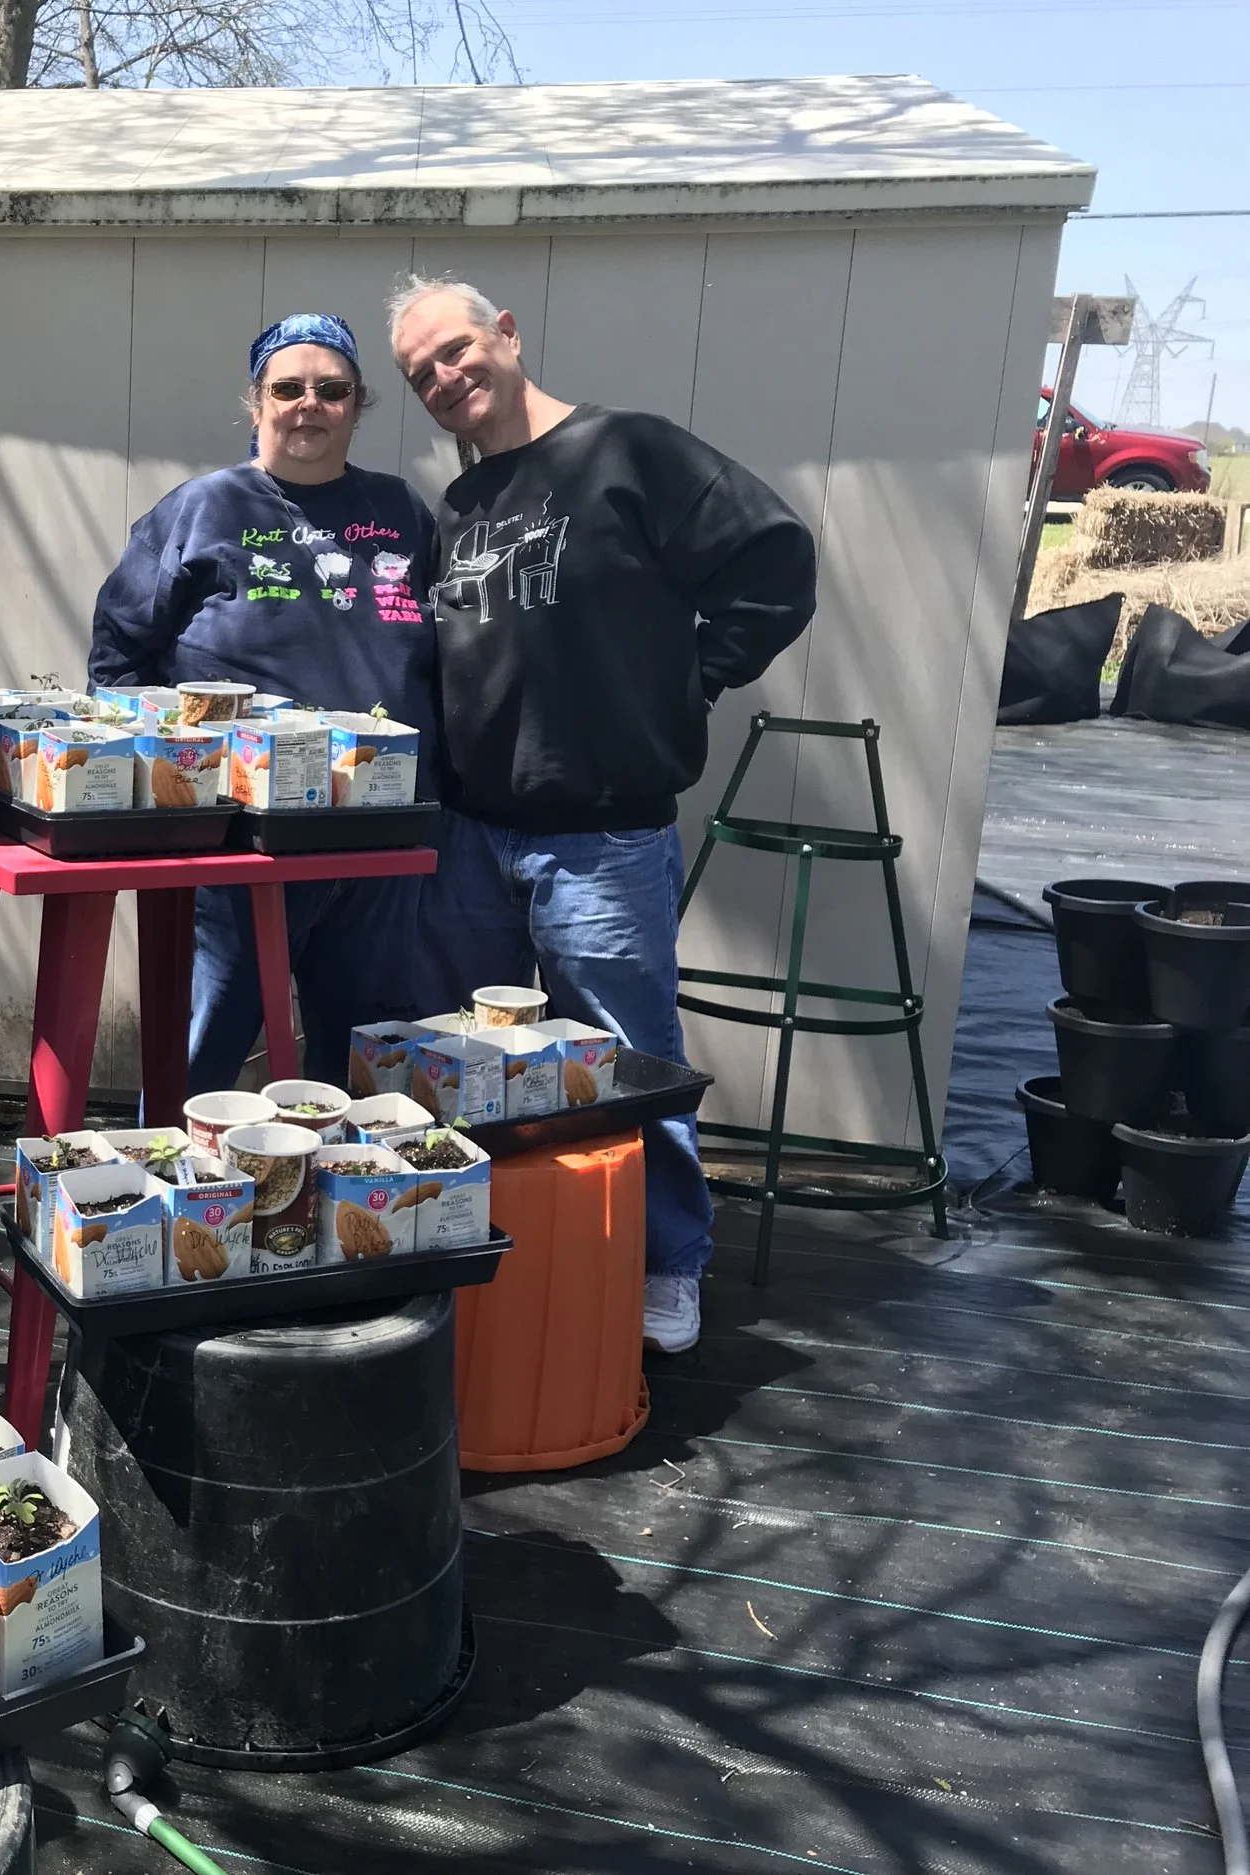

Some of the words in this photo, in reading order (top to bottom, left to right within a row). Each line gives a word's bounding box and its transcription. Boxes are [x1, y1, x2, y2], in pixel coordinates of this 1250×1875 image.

[242, 528, 287, 546] Knit
[345, 521, 400, 541] Others
[247, 585, 301, 601] SLEEP
[375, 596, 419, 609] WITH
[379, 610, 423, 623] YARN
[198, 1191, 233, 1199] ORIGINAL
[372, 1192, 385, 1202] 30
[442, 1197, 472, 1207] REASONS
[209, 1207, 221, 1217] 30
[189, 1231, 210, 1249] Dr
[47, 1582, 70, 1597] GREAT
[37, 1584, 79, 1611] REASONS
[48, 1605, 57, 1613] TO
[57, 1599, 69, 1608] TRY
[35, 1604, 81, 1632] ALMONDMILK
[32, 1635, 52, 1650] 75%
[21, 1666, 43, 1681] 30%
